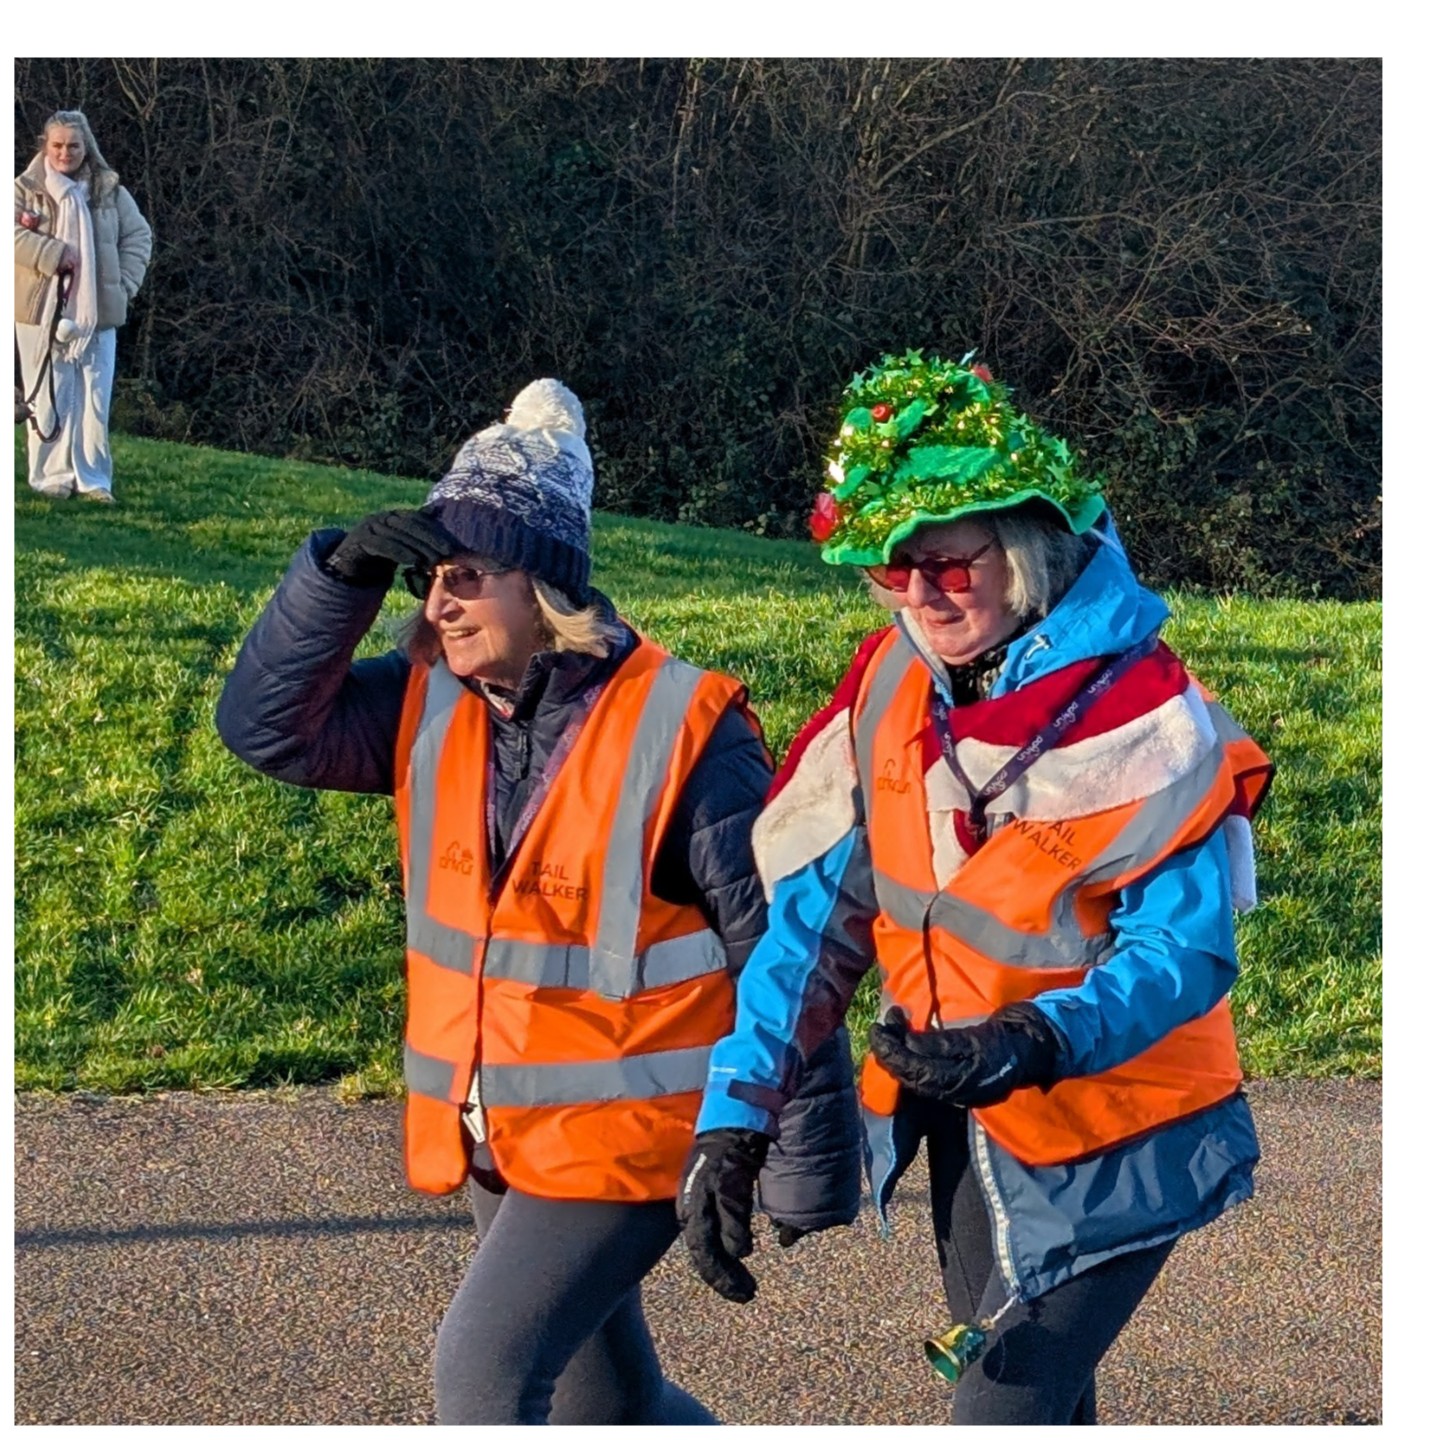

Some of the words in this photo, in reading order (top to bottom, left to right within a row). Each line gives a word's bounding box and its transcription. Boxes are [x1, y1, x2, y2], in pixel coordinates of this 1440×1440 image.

[1013, 818, 1082, 871] WALKER
[1040, 819, 1076, 847] AIL
[531, 860, 569, 880] TAIL
[512, 878, 588, 901] WALKER
